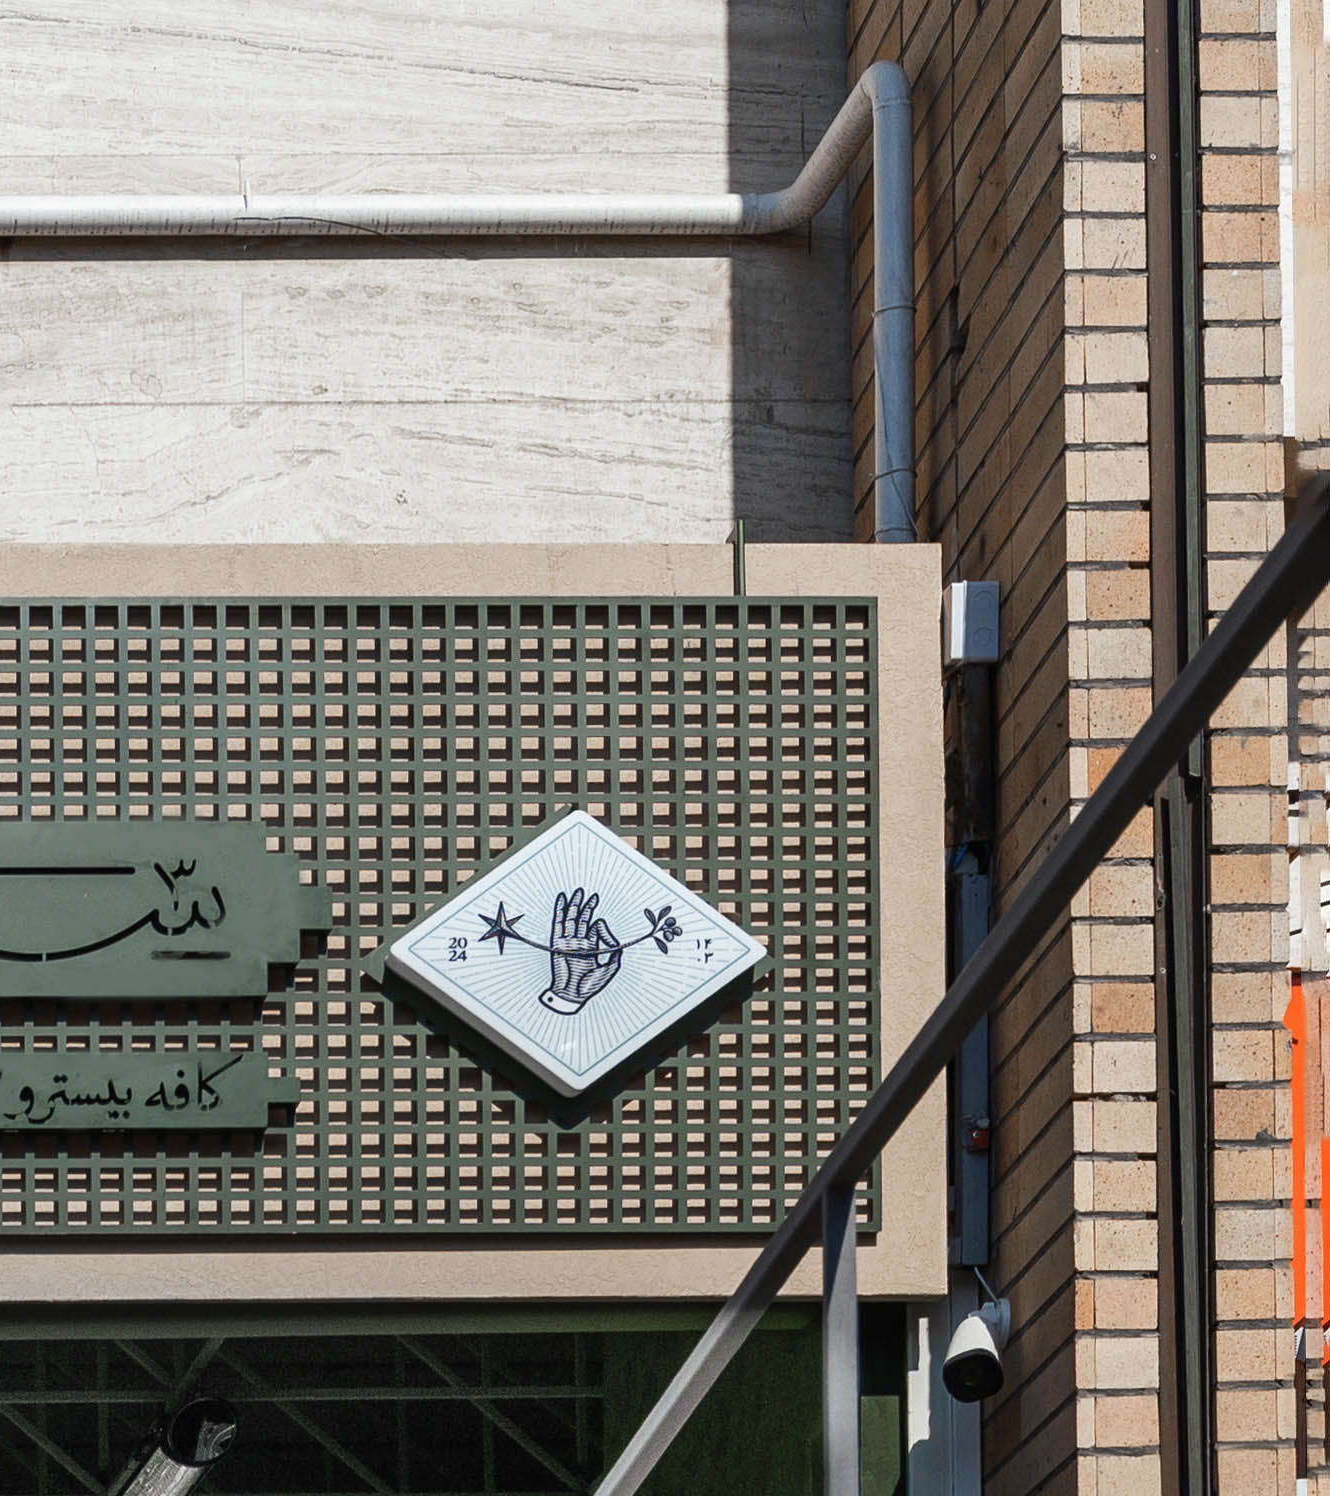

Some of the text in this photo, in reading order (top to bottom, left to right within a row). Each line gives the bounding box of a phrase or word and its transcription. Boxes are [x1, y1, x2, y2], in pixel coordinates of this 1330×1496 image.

[448, 937, 467, 949] 20
[448, 949, 467, 962] 24
[145, 1054, 244, 1112] کافه
